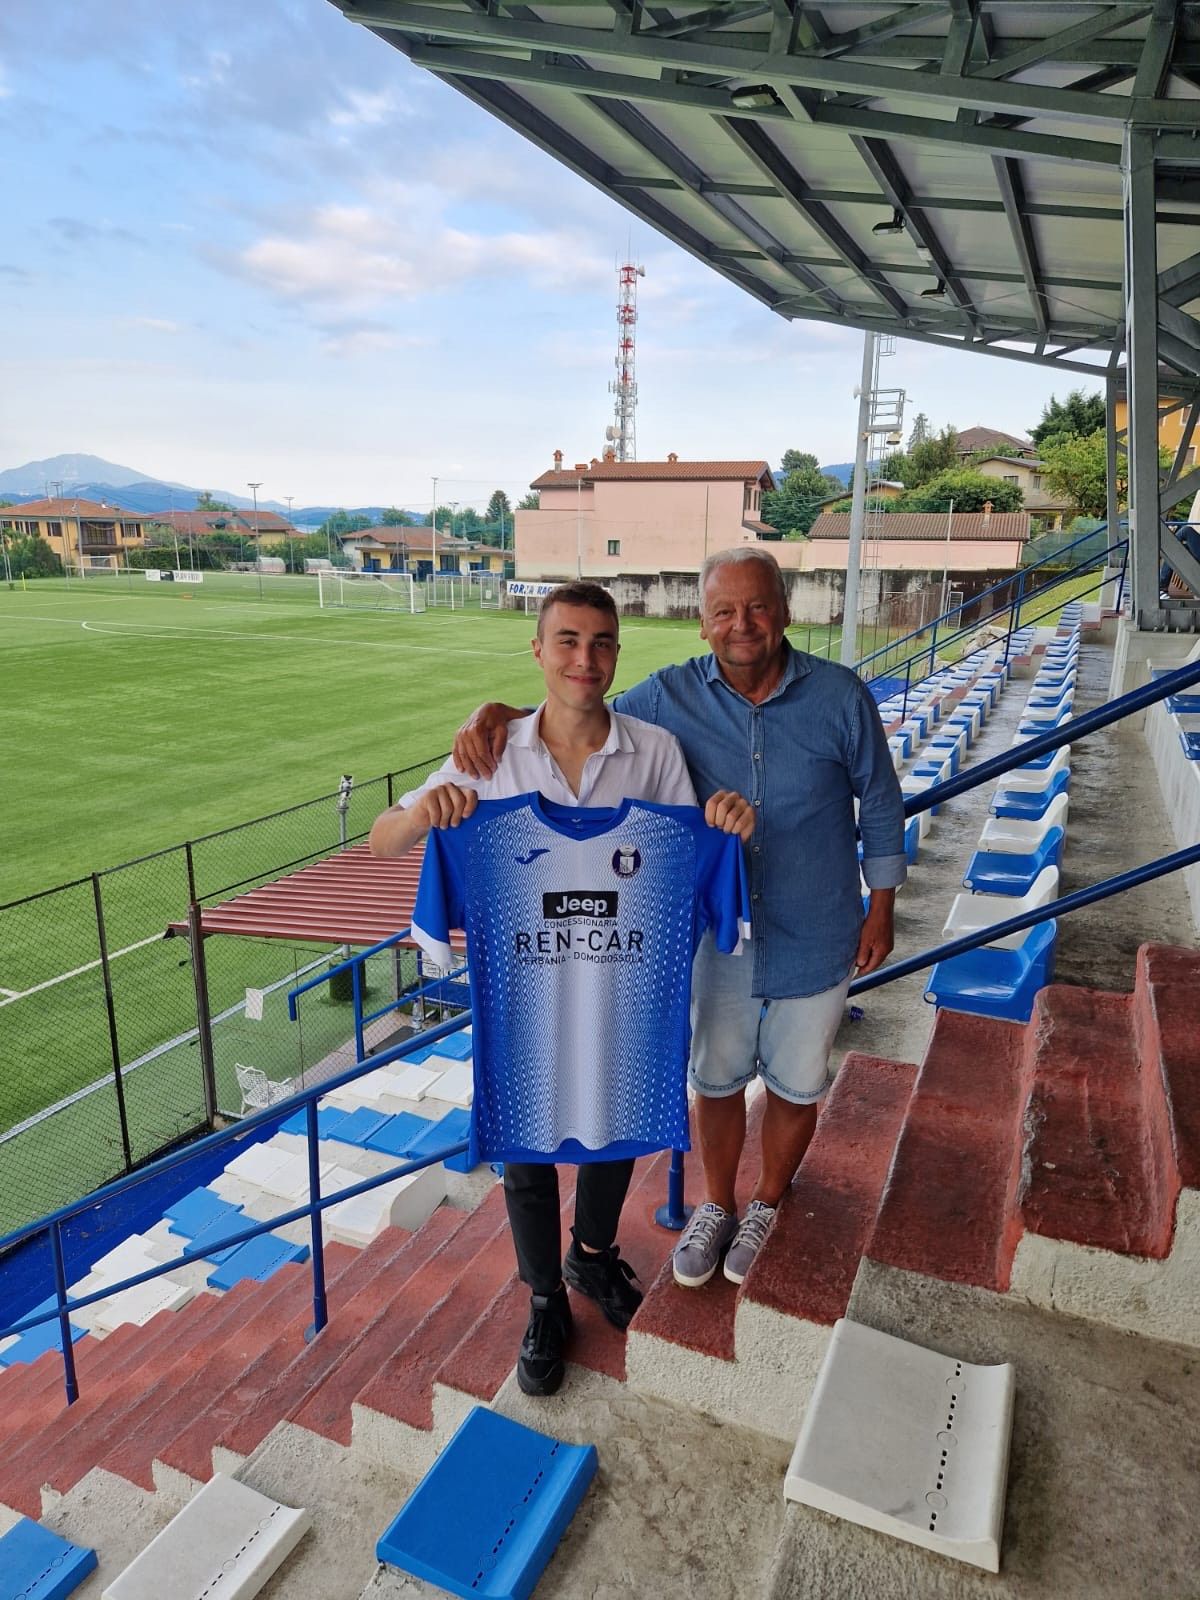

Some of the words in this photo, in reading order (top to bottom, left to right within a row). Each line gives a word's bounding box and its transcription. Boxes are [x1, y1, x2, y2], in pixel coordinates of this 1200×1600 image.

[556, 896, 608, 916] Jeep
[544, 918, 618, 929] CONCESSIONARIA
[515, 929, 645, 954] REN-CAR
[518, 955, 566, 965] VERBANIA
[573, 951, 644, 964] DOMODOSSOLA
